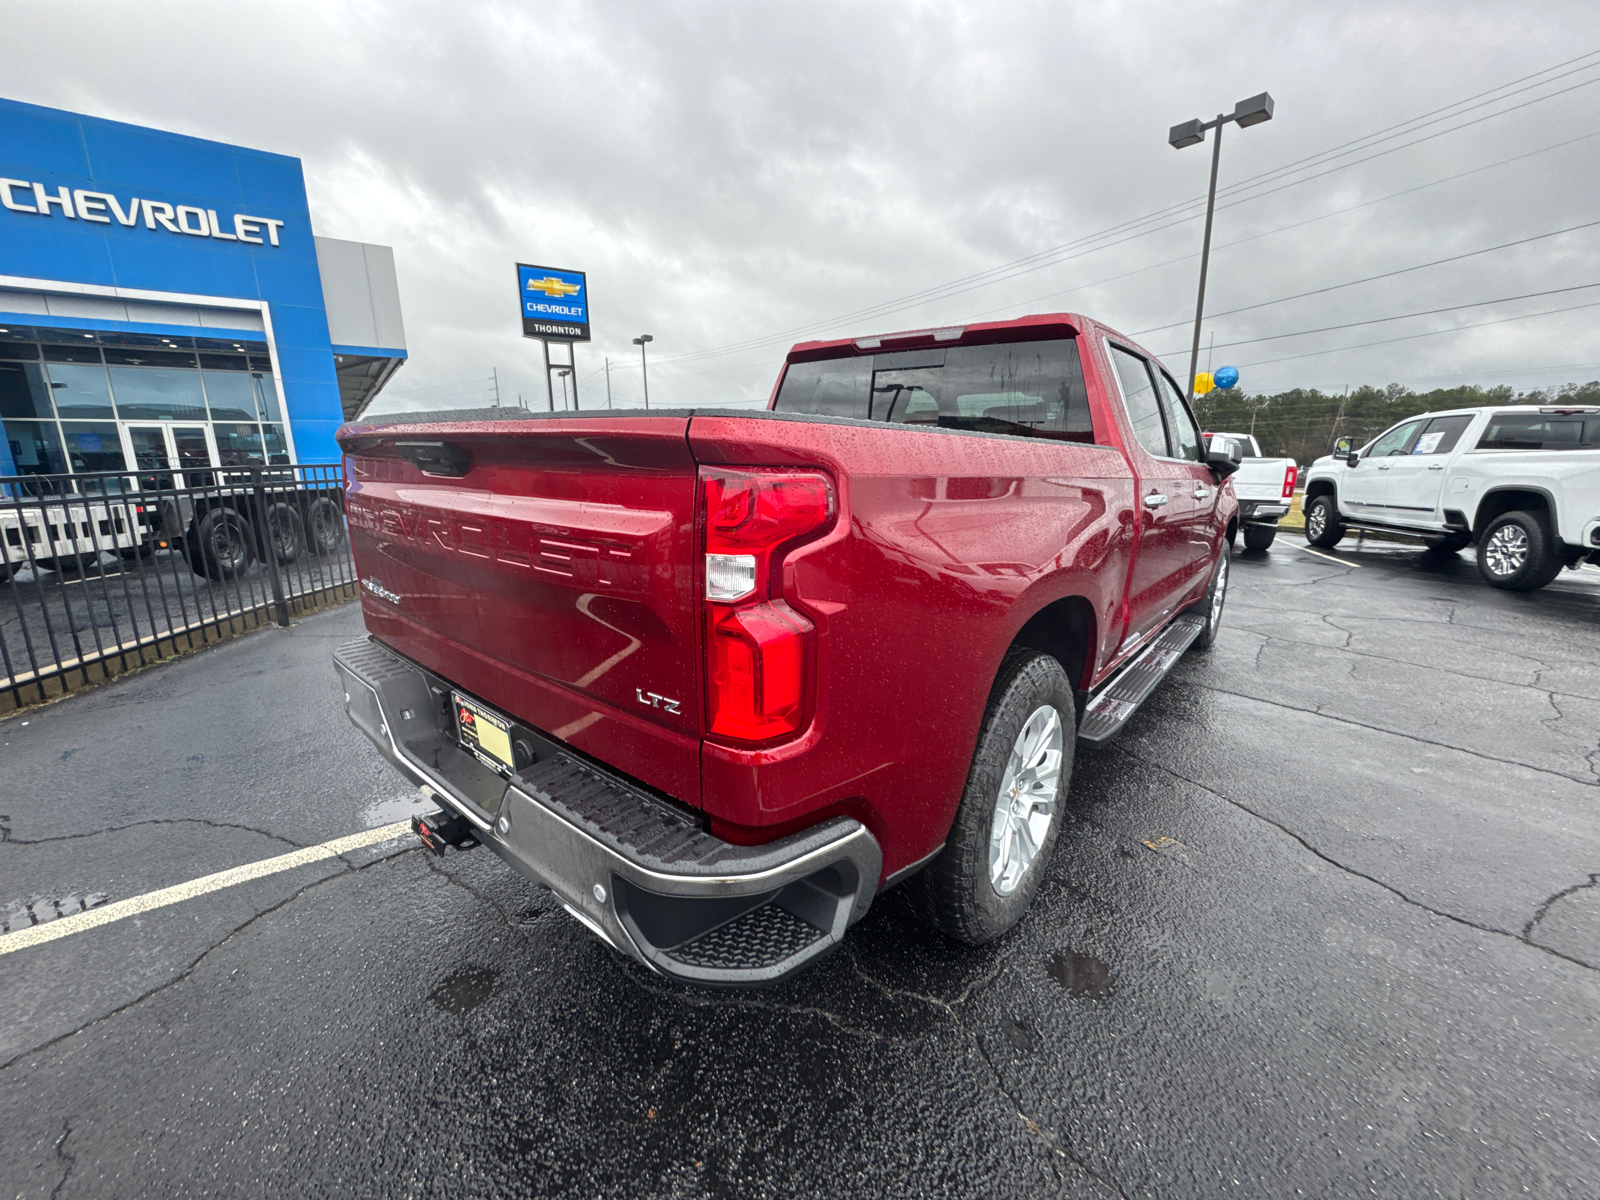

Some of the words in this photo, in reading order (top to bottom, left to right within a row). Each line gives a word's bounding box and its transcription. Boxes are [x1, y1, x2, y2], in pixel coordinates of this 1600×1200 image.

[0, 177, 284, 247] CHEVROLET
[526, 302, 583, 316] CHEVROLET
[534, 323, 581, 335] THORNTON
[346, 500, 633, 585] CHEVROLET
[635, 688, 681, 715] LTZ
